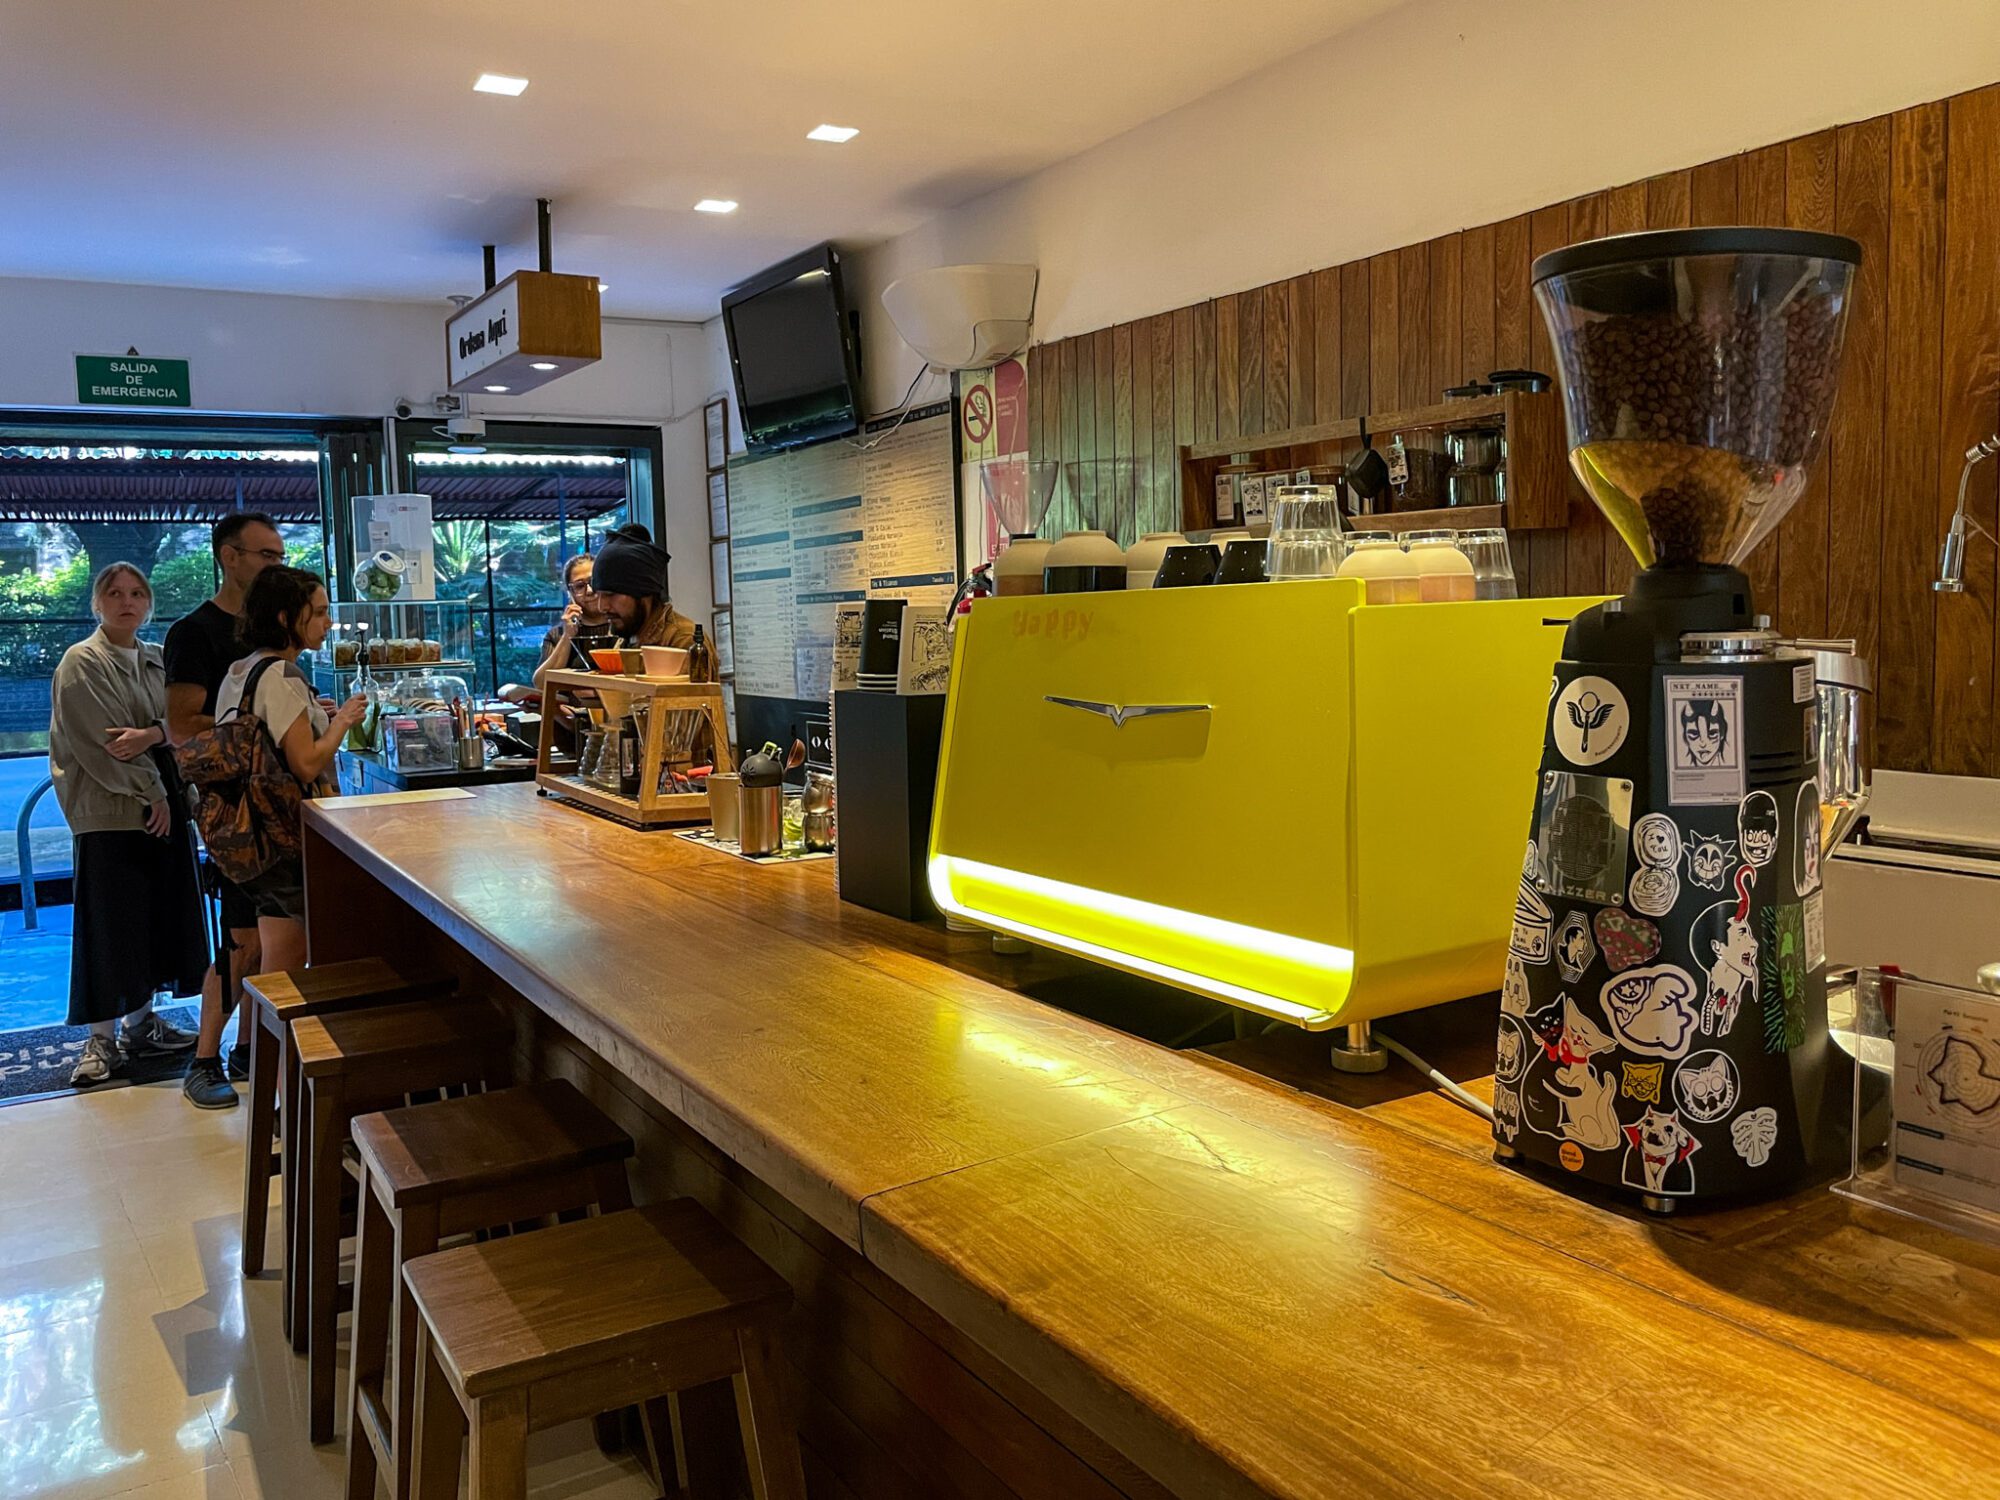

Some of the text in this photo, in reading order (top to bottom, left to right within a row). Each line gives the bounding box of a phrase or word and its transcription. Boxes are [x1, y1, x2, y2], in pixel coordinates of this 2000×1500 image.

[110, 362, 158, 373] SALIDA
[126, 375, 143, 385] DE
[92, 386, 178, 398] EMERGENCIA
